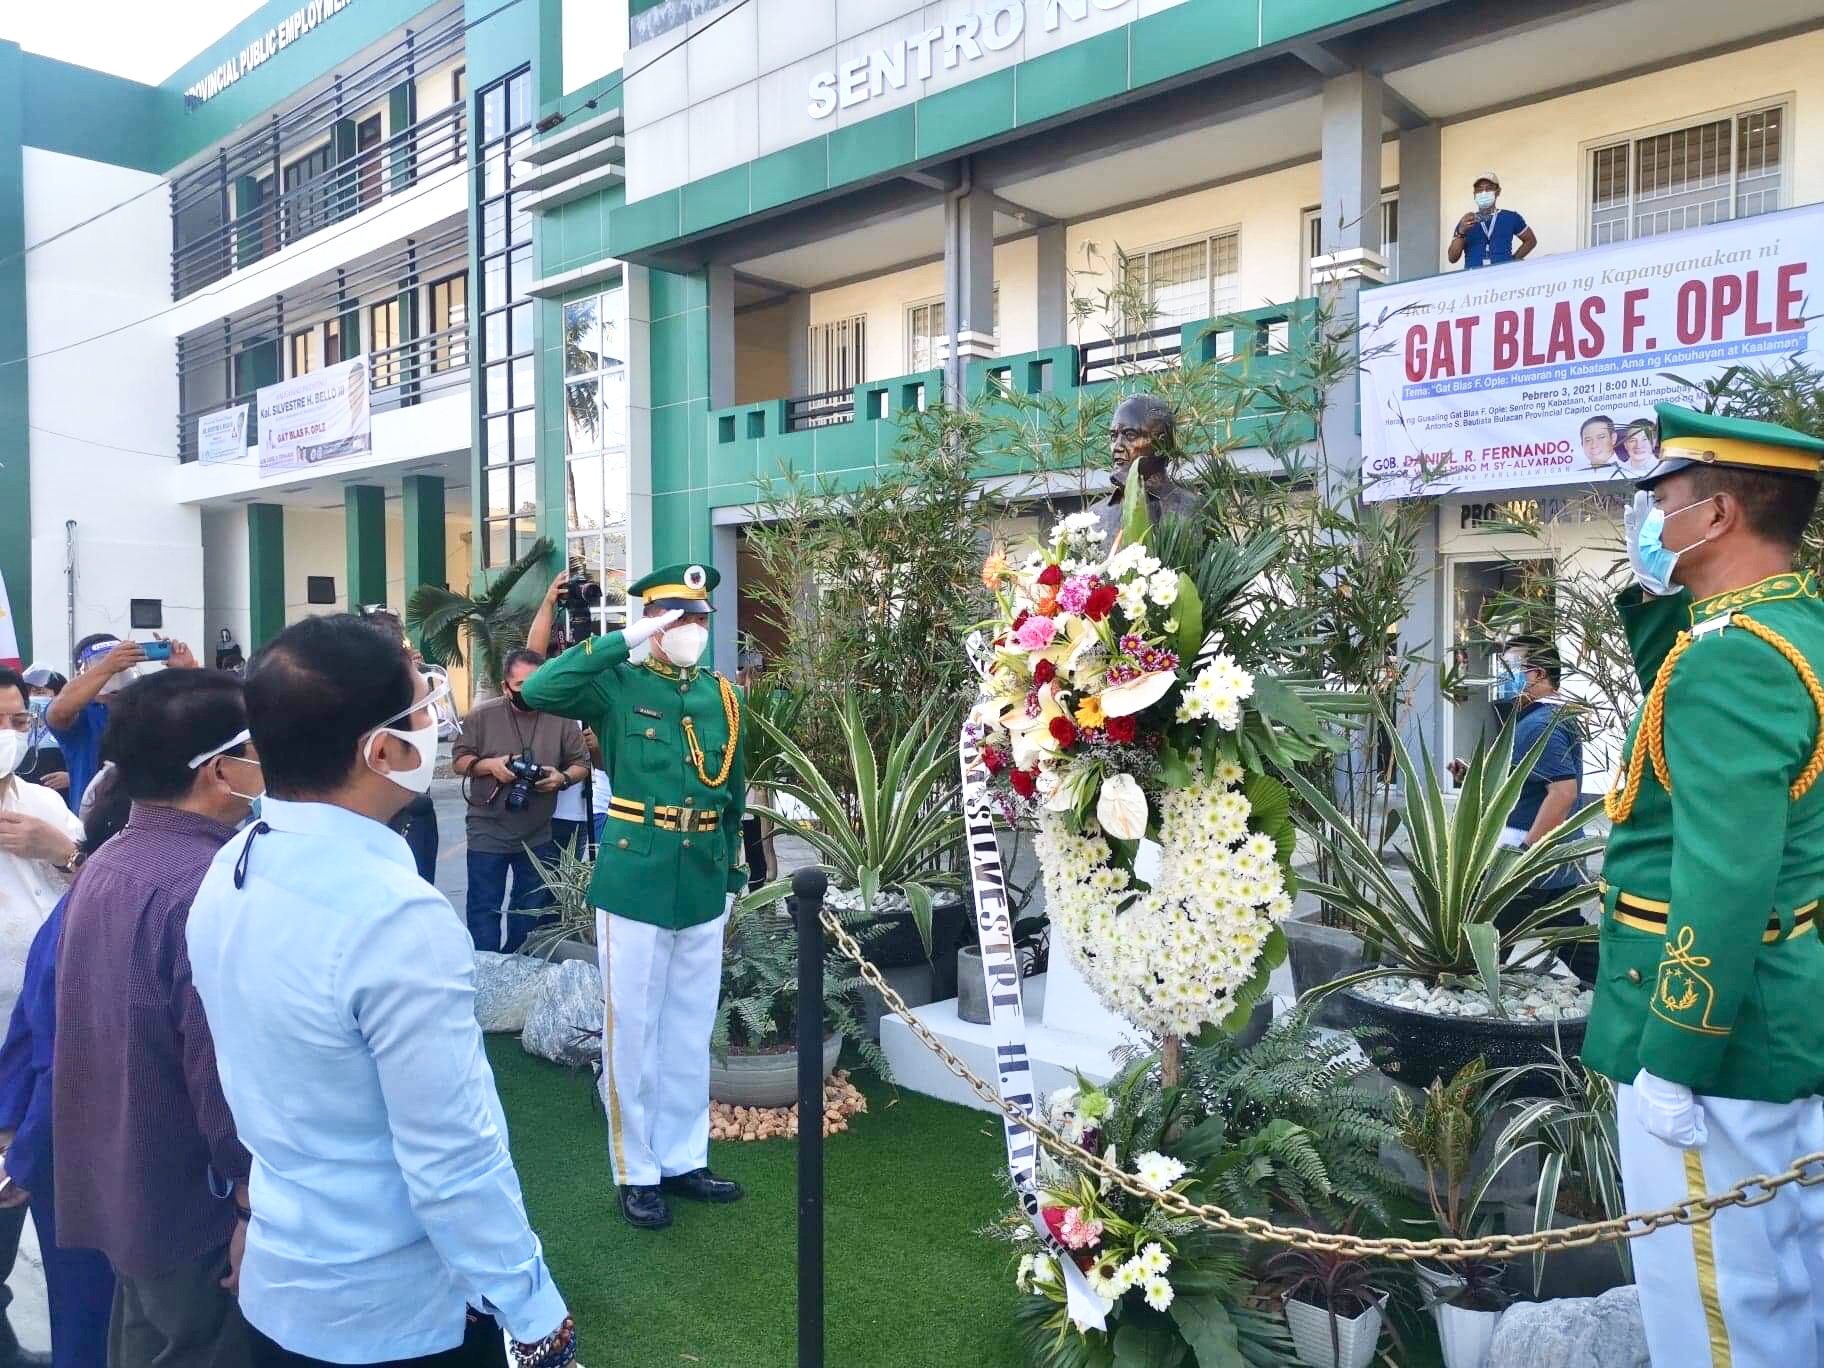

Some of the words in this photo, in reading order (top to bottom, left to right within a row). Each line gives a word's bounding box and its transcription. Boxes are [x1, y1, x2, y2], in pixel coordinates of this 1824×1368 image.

[239, 29, 277, 75] PUBLIC
[807, 0, 1025, 119] SENTRO
[1460, 279, 1567, 308] Anibersaryo
[1572, 274, 1595, 291] ng
[1600, 248, 1751, 287] Kapanganakan
[1758, 238, 1780, 258] ni
[1405, 315, 1480, 383] GAT
[1493, 293, 1606, 372] BLAS
[1622, 287, 1657, 354] F.
[1676, 261, 1808, 346] OPLE
[1453, 380, 1473, 392] Blas
[1484, 375, 1508, 389] Ople:
[1511, 370, 1551, 383] Huwaran
[1554, 368, 1567, 380] ng
[1569, 361, 1619, 376] Kabataan,
[1621, 357, 1645, 370] Ama
[1647, 355, 1661, 367] ng
[1664, 348, 1725, 364] Kabuhayan
[1728, 344, 1739, 356] at
[272, 396, 306, 416] SILVESTRE
[314, 388, 337, 404] BELLO
[1522, 389, 1559, 401] Pebrero
[1561, 387, 1570, 398] 3,
[1573, 383, 1596, 396] 2021
[1605, 379, 1628, 392] 8:00
[1630, 376, 1652, 389] N.U.
[1450, 411, 1462, 420] Gat
[1509, 402, 1534, 413] Sentro
[1536, 402, 1546, 411] ng
[289, 427, 304, 441] BLAS
[1373, 456, 1399, 471] GOB.
[1464, 449, 1477, 462] R.
[1494, 455, 1573, 471] SY-ALVARADO
